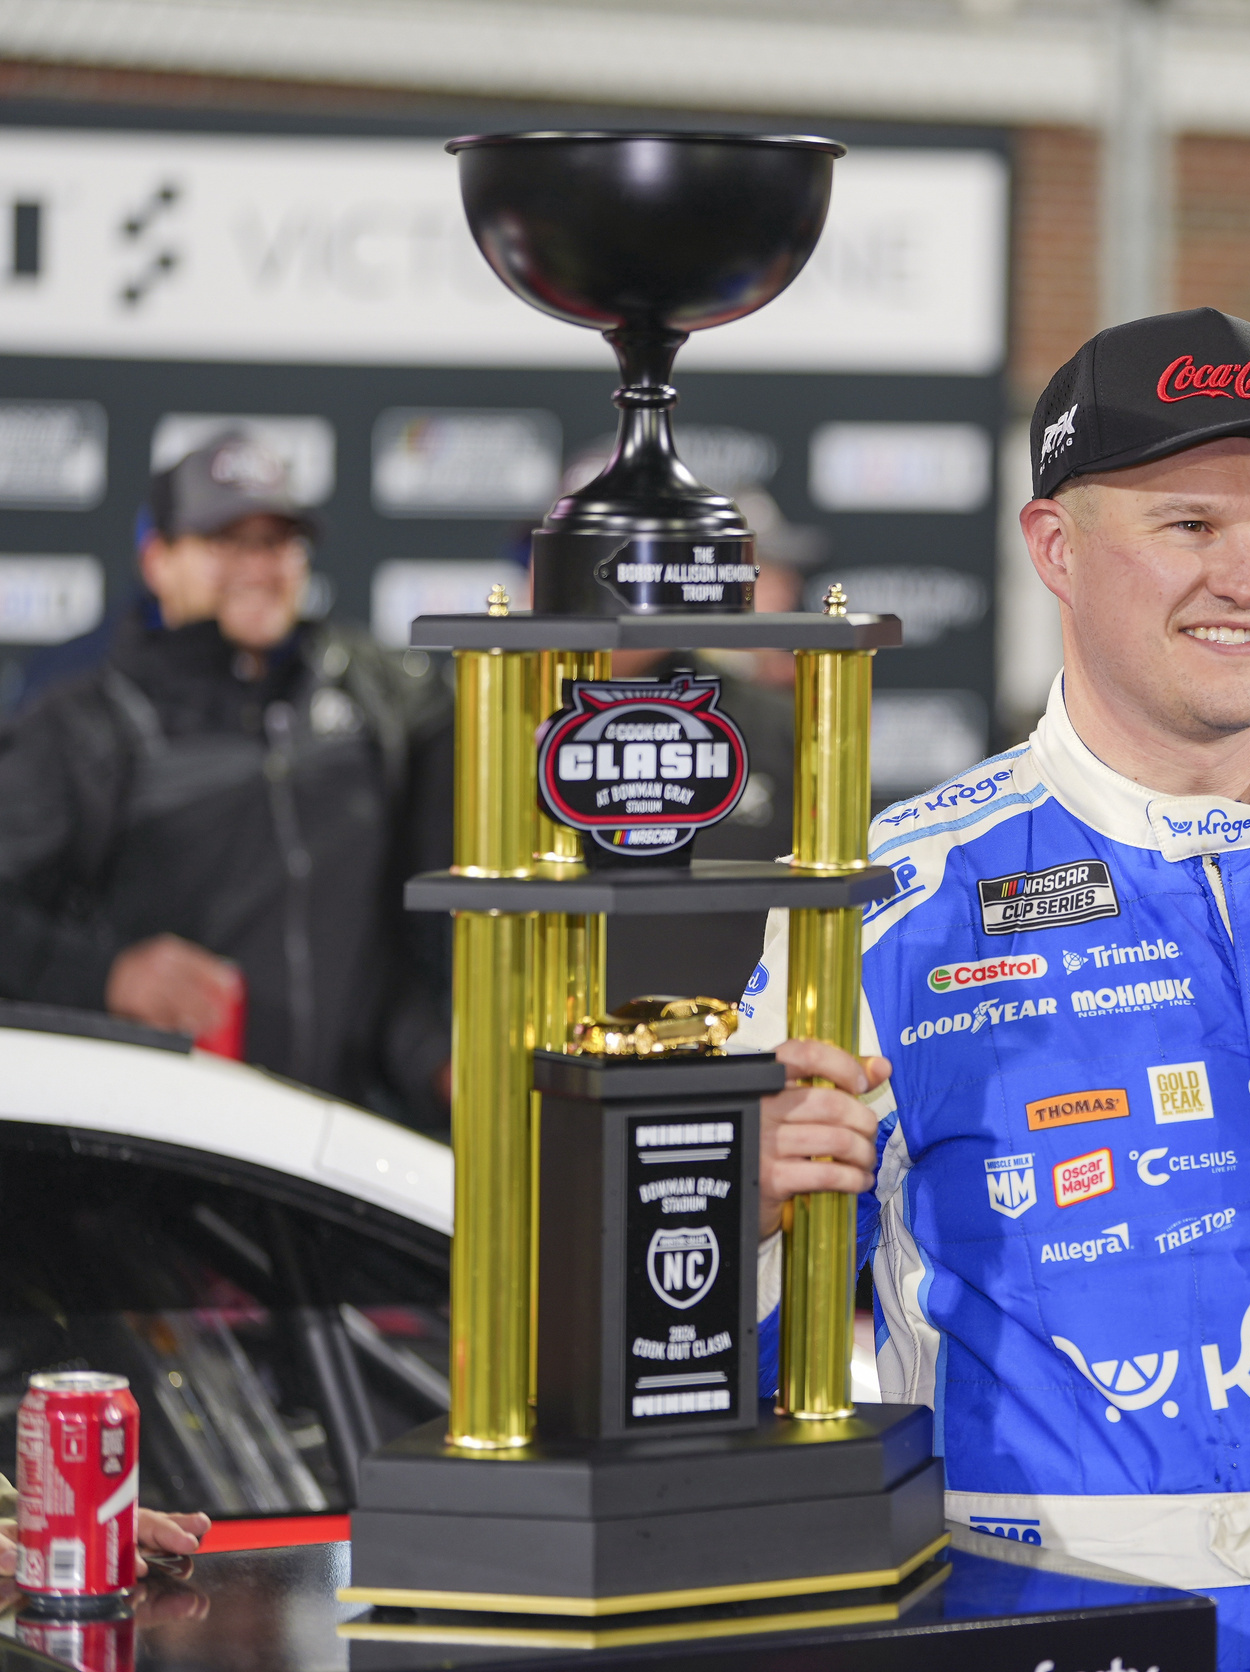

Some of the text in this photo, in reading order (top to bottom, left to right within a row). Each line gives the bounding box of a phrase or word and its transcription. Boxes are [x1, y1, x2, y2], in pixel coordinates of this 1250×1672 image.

[693, 546, 715, 564] THE
[664, 563, 717, 582] ALLISON
[681, 584, 724, 602] TROPHY
[558, 742, 729, 781] CLASH
[663, 783, 695, 806] GRAY
[628, 828, 678, 845] NASCAR
[1023, 865, 1090, 895] NASCAR
[1002, 889, 1096, 920] CUP SERIES
[1087, 938, 1181, 968] Trimble
[954, 957, 1039, 985] Castrol
[1071, 977, 1195, 1013] MOHAWK
[1078, 999, 1196, 1018] NORTHEAST, INC.
[1157, 1070, 1200, 1092] GOLD
[1160, 1089, 1205, 1111] PEAK
[987, 1156, 1030, 1170] MUSCLE MILK
[1062, 1158, 1103, 1182] Oscar
[1169, 1150, 1237, 1171] CELSIUS
[1226, 1165, 1237, 1173] FIT
[696, 1176, 731, 1199] GRAY
[1062, 1171, 1106, 1196] Mayer
[1040, 1236, 1123, 1263] Allegra
[666, 1341, 692, 1361] OUT
[692, 1330, 732, 1359] CLASH
